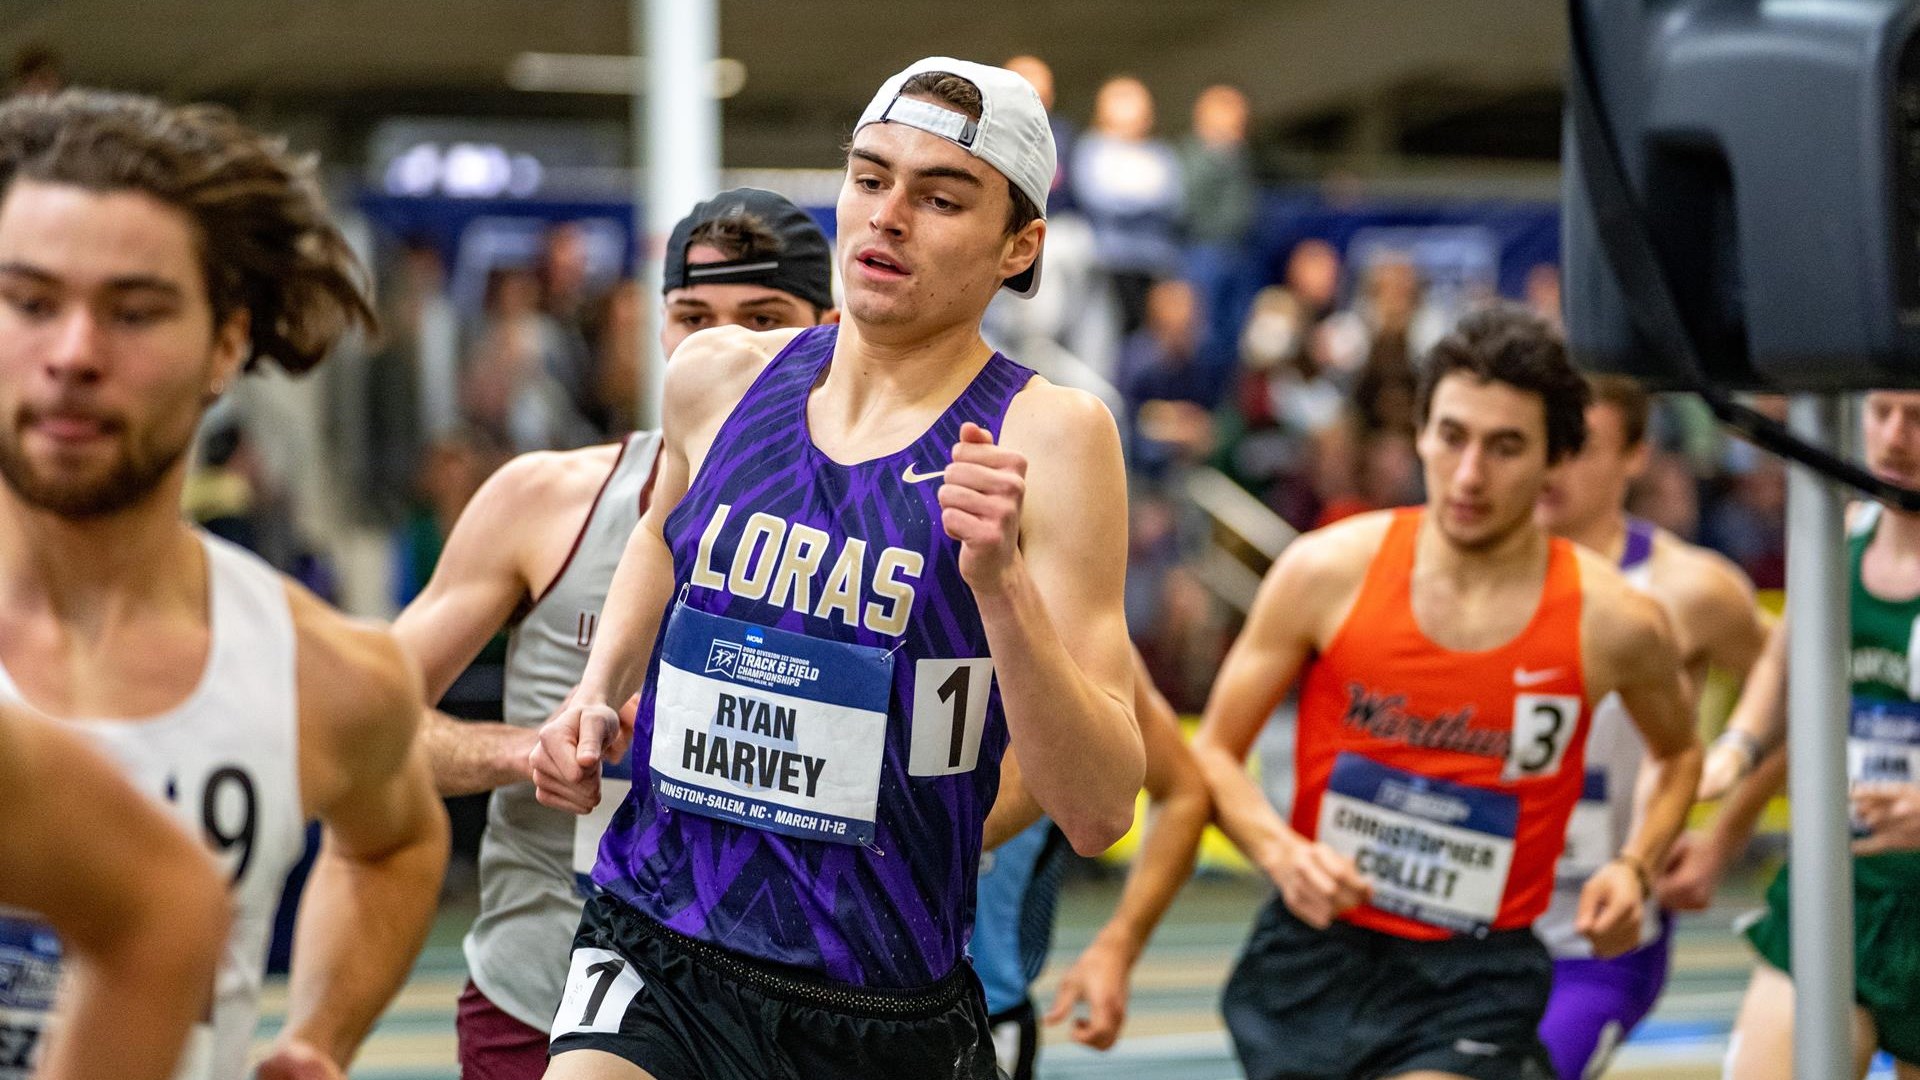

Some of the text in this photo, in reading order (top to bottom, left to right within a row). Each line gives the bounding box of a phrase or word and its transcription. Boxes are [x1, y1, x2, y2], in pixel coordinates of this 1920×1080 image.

[690, 504, 925, 637] LORAS
[741, 653, 820, 681] TRACK & FIELD
[742, 646, 757, 655] 2022
[757, 650, 780, 660] DIVISION
[746, 635, 763, 644] NCAA
[737, 666, 800, 687] CHAMPIONSHIPS
[716, 692, 797, 742] RYAN
[936, 665, 971, 768] 1
[1518, 703, 1563, 772] 3
[681, 728, 827, 798] HARVEY
[202, 765, 256, 891] 9
[659, 779, 747, 817] WINSTON-SALEM,
[749, 803, 768, 819] NC
[774, 809, 817, 830] MARCH
[819, 819, 847, 835] 11-12
[1333, 806, 1495, 868] CHRISTOPHER
[1355, 847, 1459, 898] COLLET
[578, 958, 626, 1027] 1
